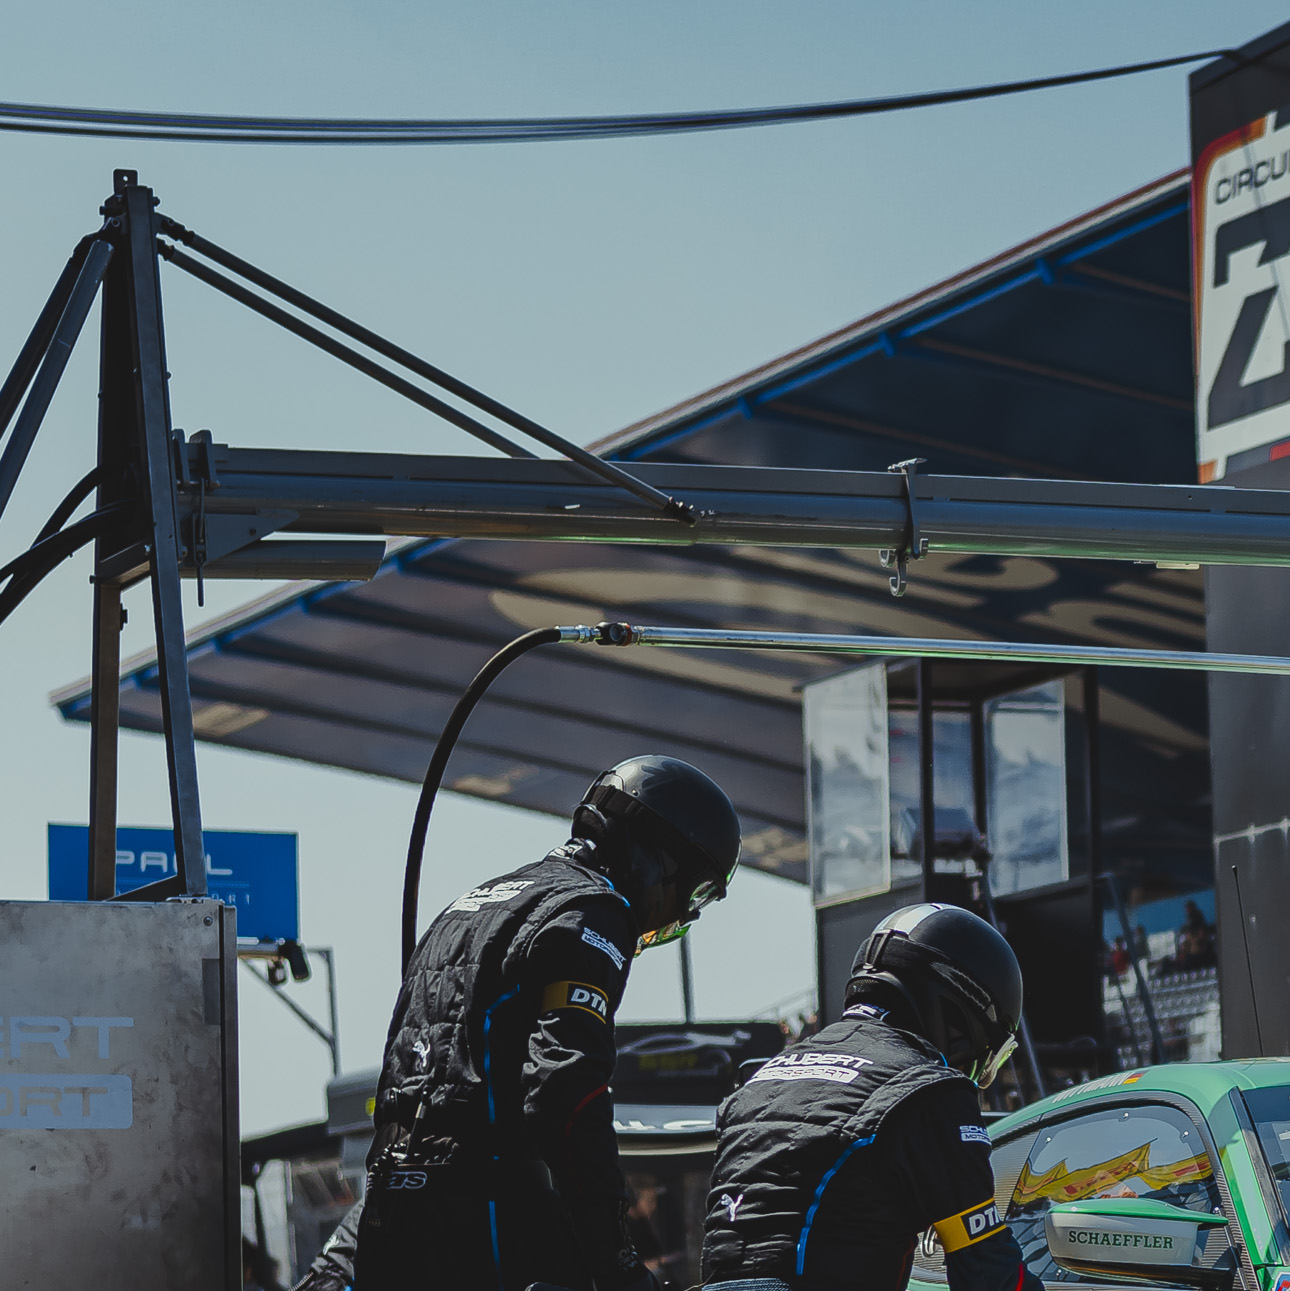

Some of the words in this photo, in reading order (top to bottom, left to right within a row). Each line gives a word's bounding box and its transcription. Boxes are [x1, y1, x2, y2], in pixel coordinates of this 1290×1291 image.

[115, 850, 233, 875] PAL
[959, 1125, 988, 1134] SCHU
[1068, 1231, 1174, 1250] SCHAEFFLER
